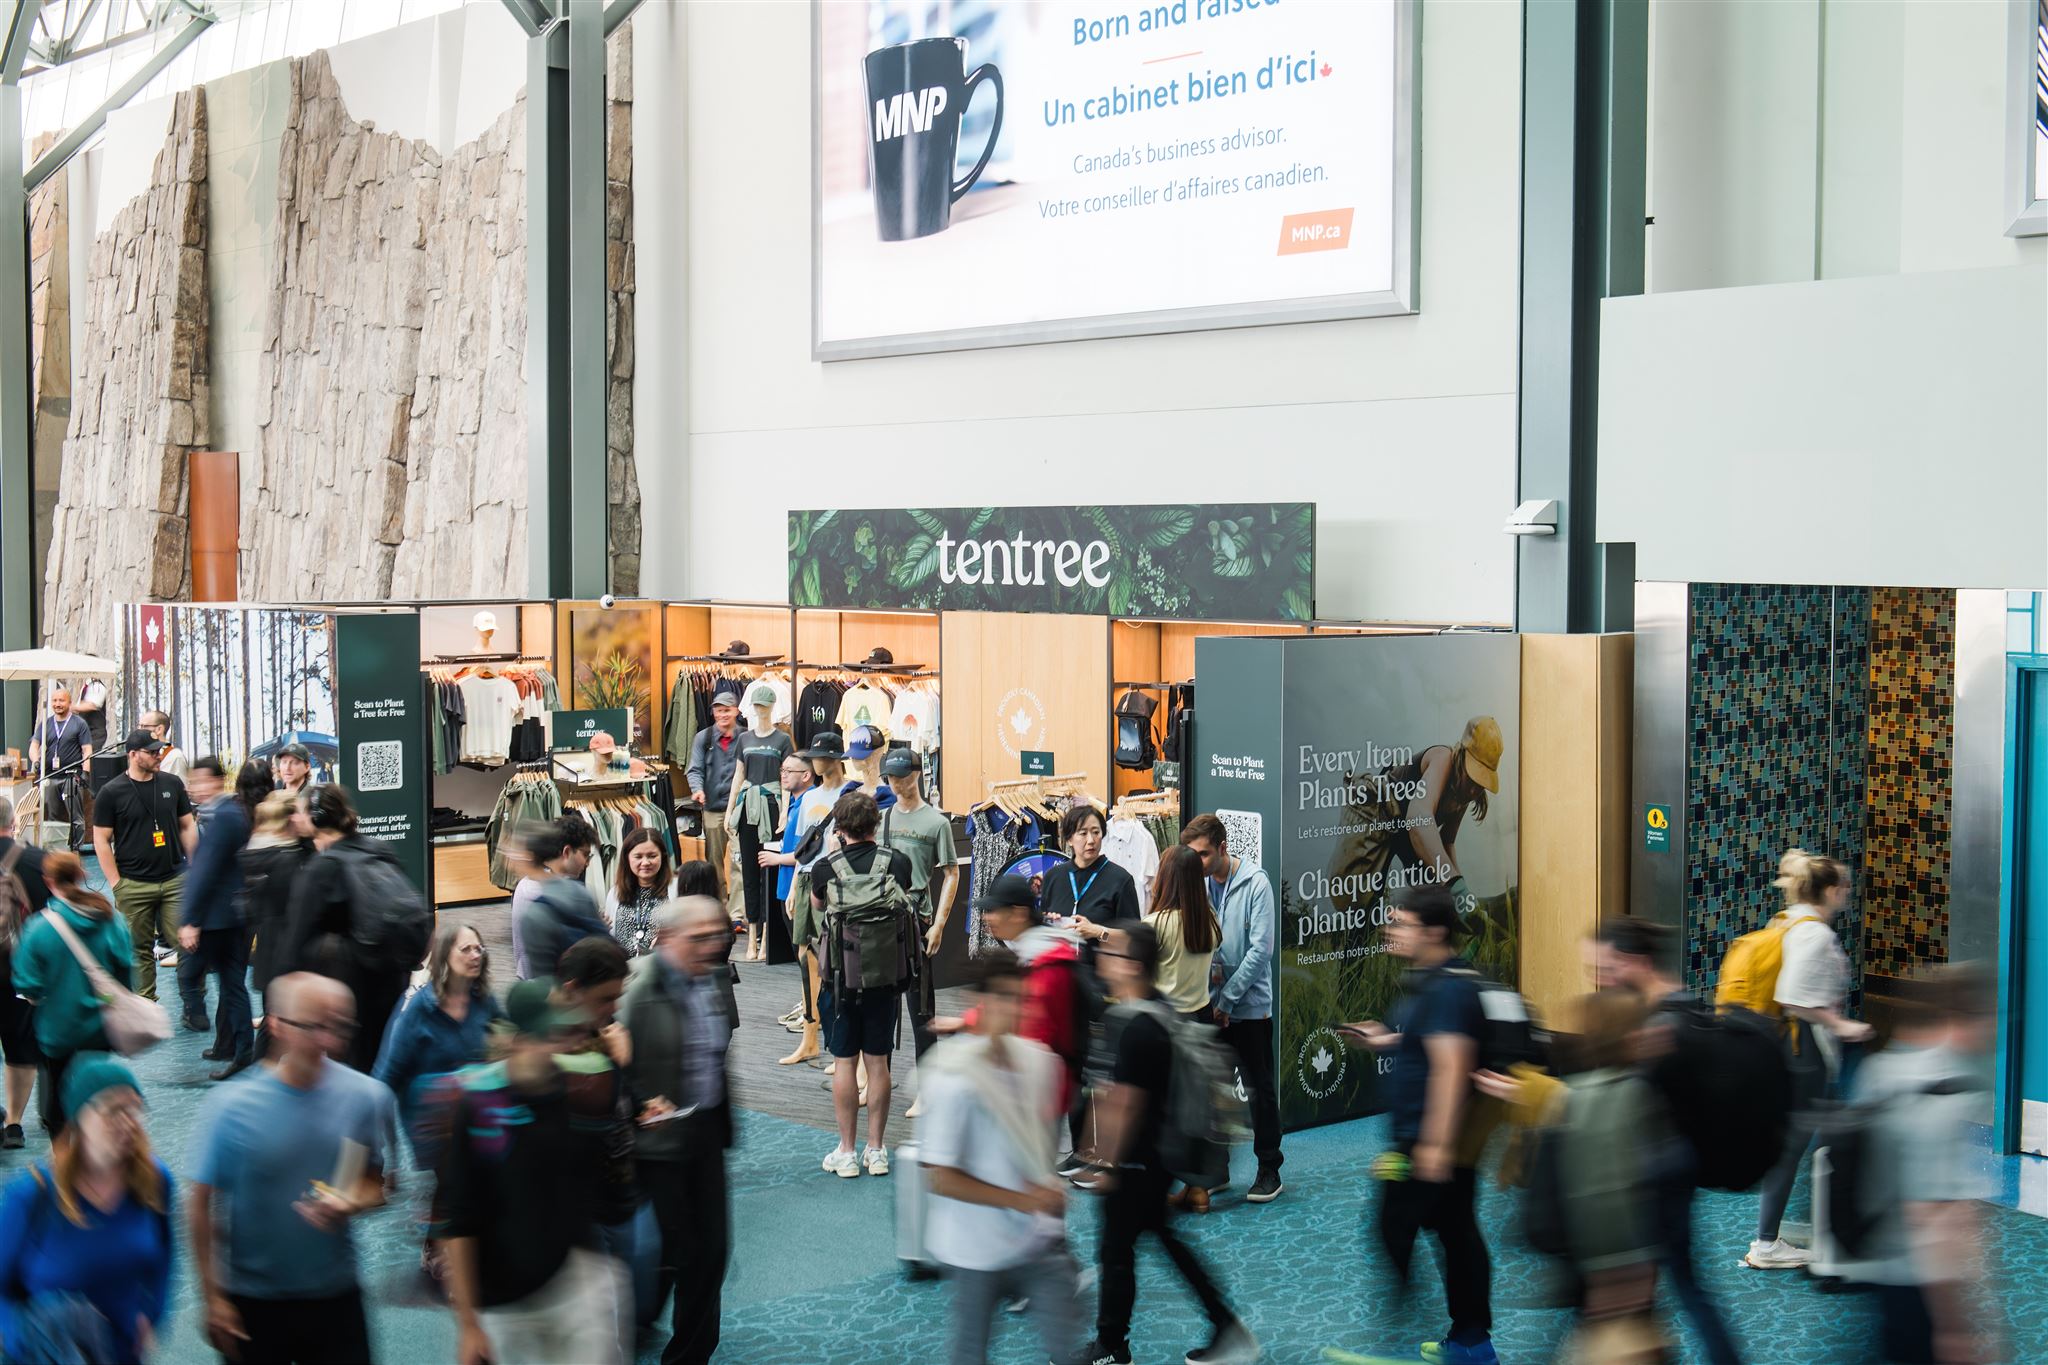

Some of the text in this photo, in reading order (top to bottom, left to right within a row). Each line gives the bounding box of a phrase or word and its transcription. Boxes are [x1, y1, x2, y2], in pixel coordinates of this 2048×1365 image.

[1073, 0, 1281, 46] Born and rais
[1044, 50, 1316, 127] Un cabinet bien d’ici
[875, 86, 948, 142] MNP
[1073, 126, 1288, 174] Canada’s business advisor.
[1038, 163, 1329, 219] Votre conseiller d’affaires canadien.
[1291, 223, 1342, 243] MNP.ca
[935, 529, 1111, 588] tentree
[354, 698, 404, 709] Scan to Plant
[360, 709, 376, 718] Tree
[377, 708, 388, 717] for
[389, 708, 405, 717] Free
[1211, 765, 1265, 780] a Tree for Free
[1212, 753, 1264, 768] Scan to Plant
[1298, 740, 1414, 778] Every Item
[1298, 774, 1427, 810] Plants Trees
[388, 814, 407, 824] pour
[390, 822, 411, 831] arbre
[1298, 815, 1434, 839] Let’s restore our planet together.
[1298, 855, 1452, 903] Chaque article
[1297, 904, 1366, 946] plante
[1297, 950, 1345, 966] Restaurons
[1346, 946, 1370, 959] notre
[1297, 1026, 1348, 1066] PROUDLY CANADIAN
[1298, 1068, 1324, 1100] CANADIAN
[1323, 1062, 1347, 1099] PROUDLY
